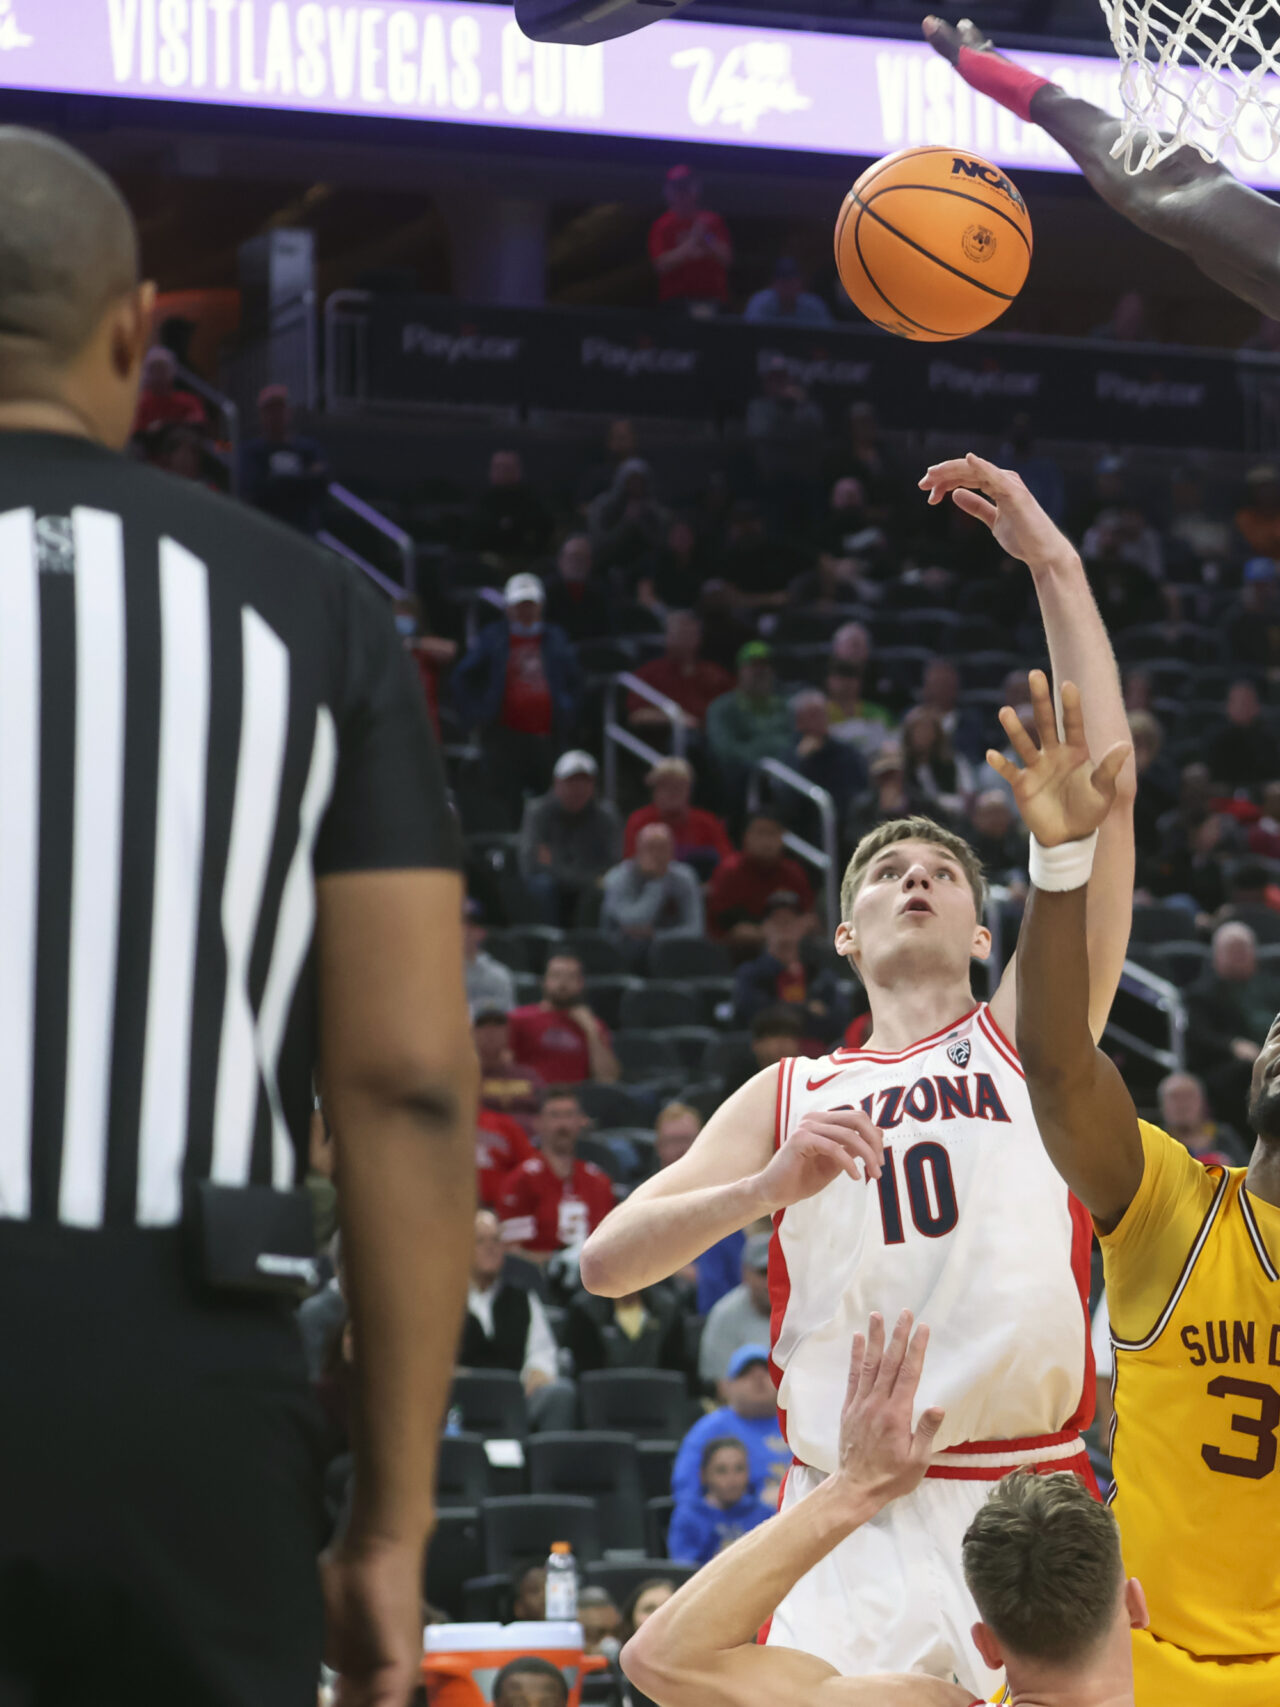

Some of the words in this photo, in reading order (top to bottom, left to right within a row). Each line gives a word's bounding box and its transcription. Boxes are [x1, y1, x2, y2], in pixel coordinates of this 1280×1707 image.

[106, 0, 606, 118] VISITLASVEGAS.COM
[827, 1072, 1013, 1130] IZONA
[864, 1140, 960, 1245] 10
[1180, 1320, 1255, 1367] SUN
